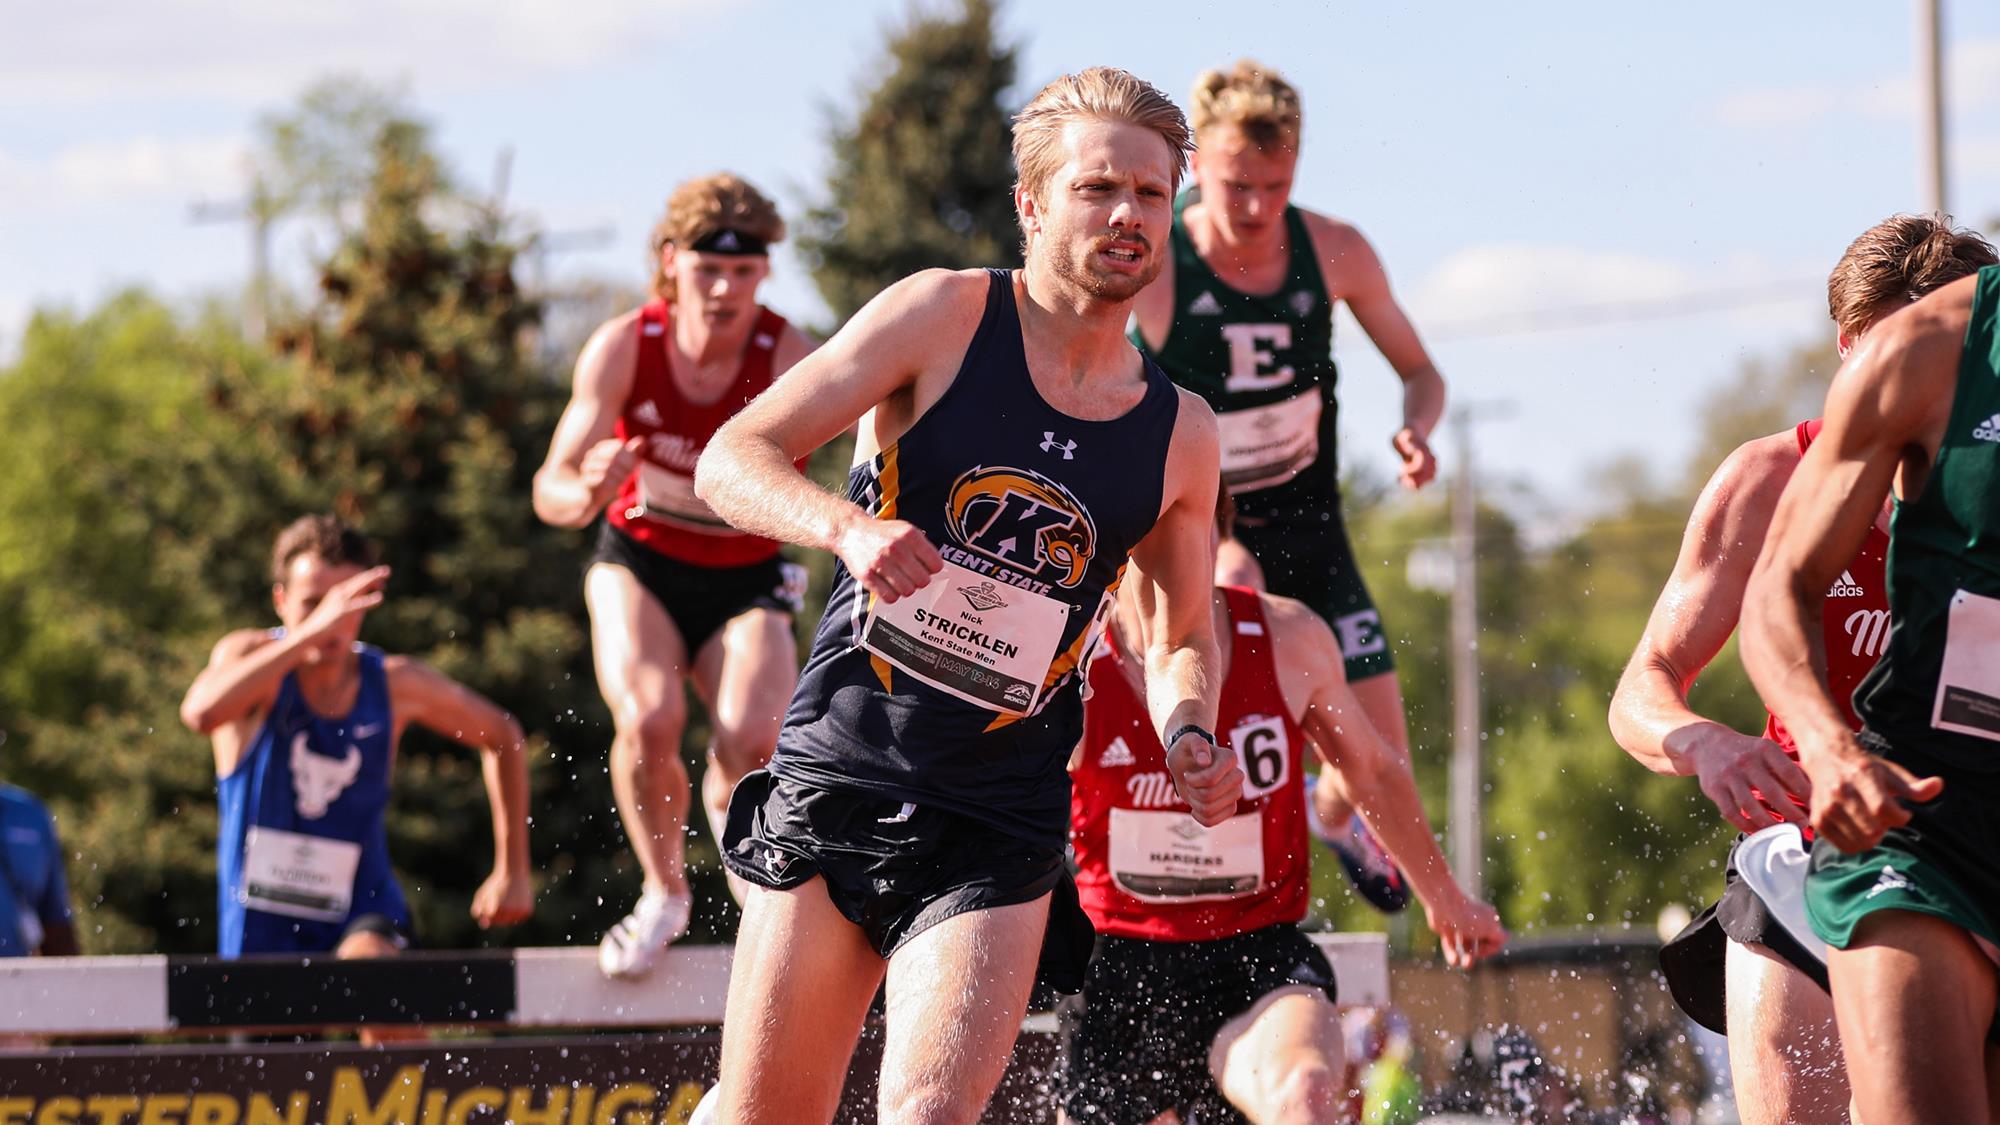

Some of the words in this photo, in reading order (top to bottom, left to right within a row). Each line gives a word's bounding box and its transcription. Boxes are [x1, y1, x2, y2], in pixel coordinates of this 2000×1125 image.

[1222, 323, 1295, 392] E
[965, 489, 1078, 575] K
[939, 543, 994, 574] KENT
[996, 569, 1054, 597] STATE
[1826, 585, 1864, 598] didas
[914, 608, 1018, 659] STRICKLEN
[960, 611, 983, 626] Nick
[1334, 609, 1386, 657] E
[921, 630, 944, 645] Kent
[946, 641, 973, 656] State
[975, 652, 996, 666] Men
[940, 657, 972, 677] MAY
[1243, 728, 1283, 788] 6
[0, 1091, 311, 1125] ESTERN
[322, 1065, 704, 1125] MICHIGA
